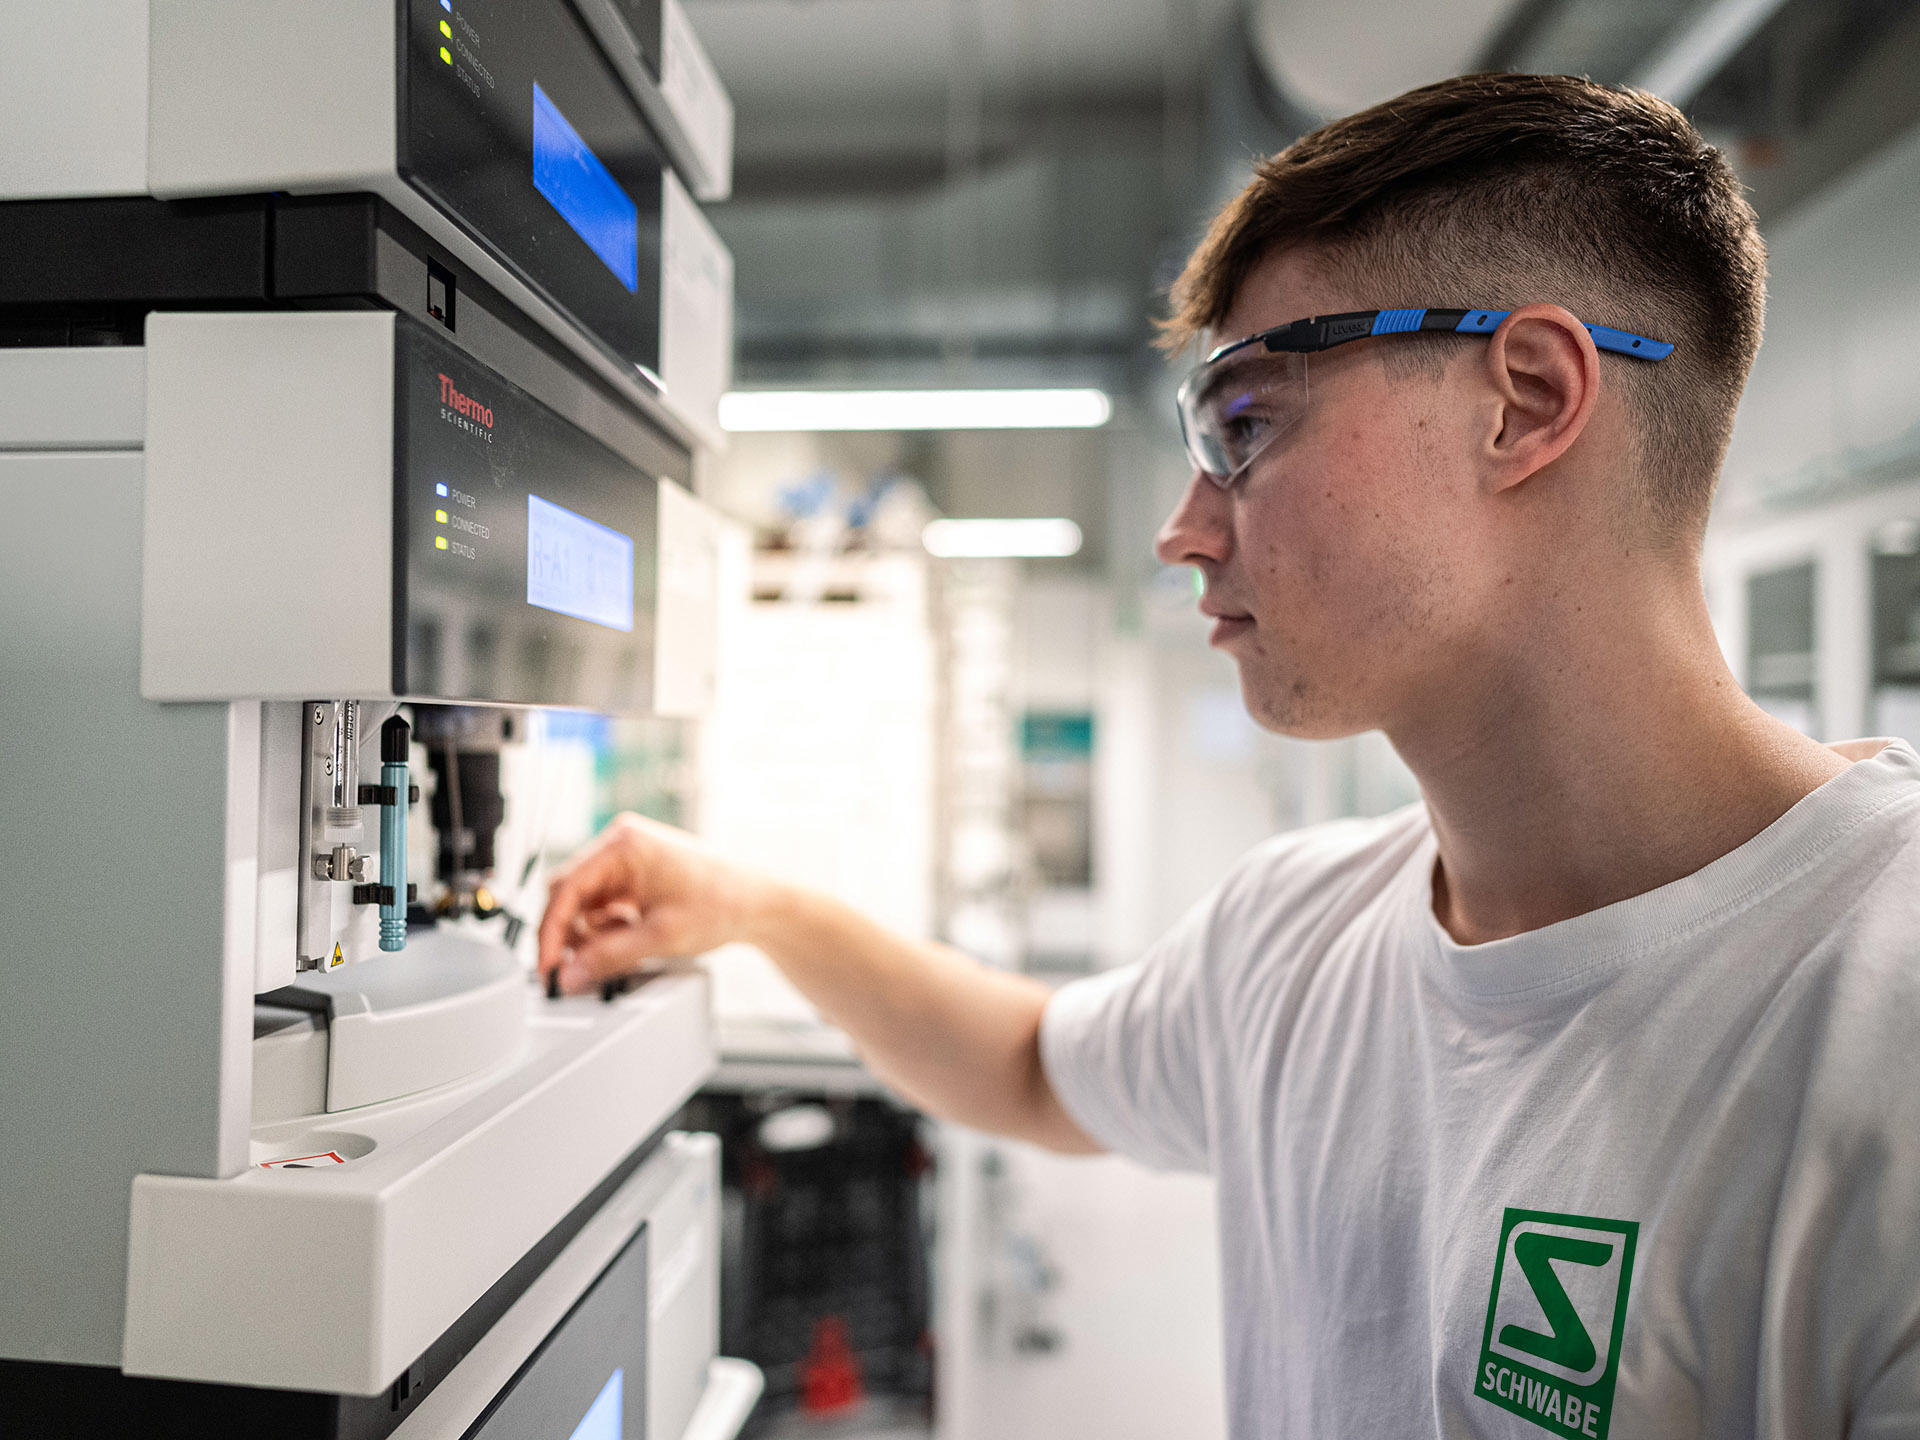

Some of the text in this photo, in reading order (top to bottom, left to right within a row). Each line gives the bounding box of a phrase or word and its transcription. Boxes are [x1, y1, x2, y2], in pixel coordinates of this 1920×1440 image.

[456, 11, 480, 48] POWER
[456, 38, 494, 89] CONNECTED
[456, 64, 480, 98] STATUS
[438, 373, 493, 429] Thermo
[441, 408, 493, 443] SCIENTIFIC
[452, 489, 476, 510] POWER
[452, 515, 490, 539] CONNECTED
[451, 541, 476, 560] STATUS
[1482, 1361, 1601, 1439] SCHWABE
